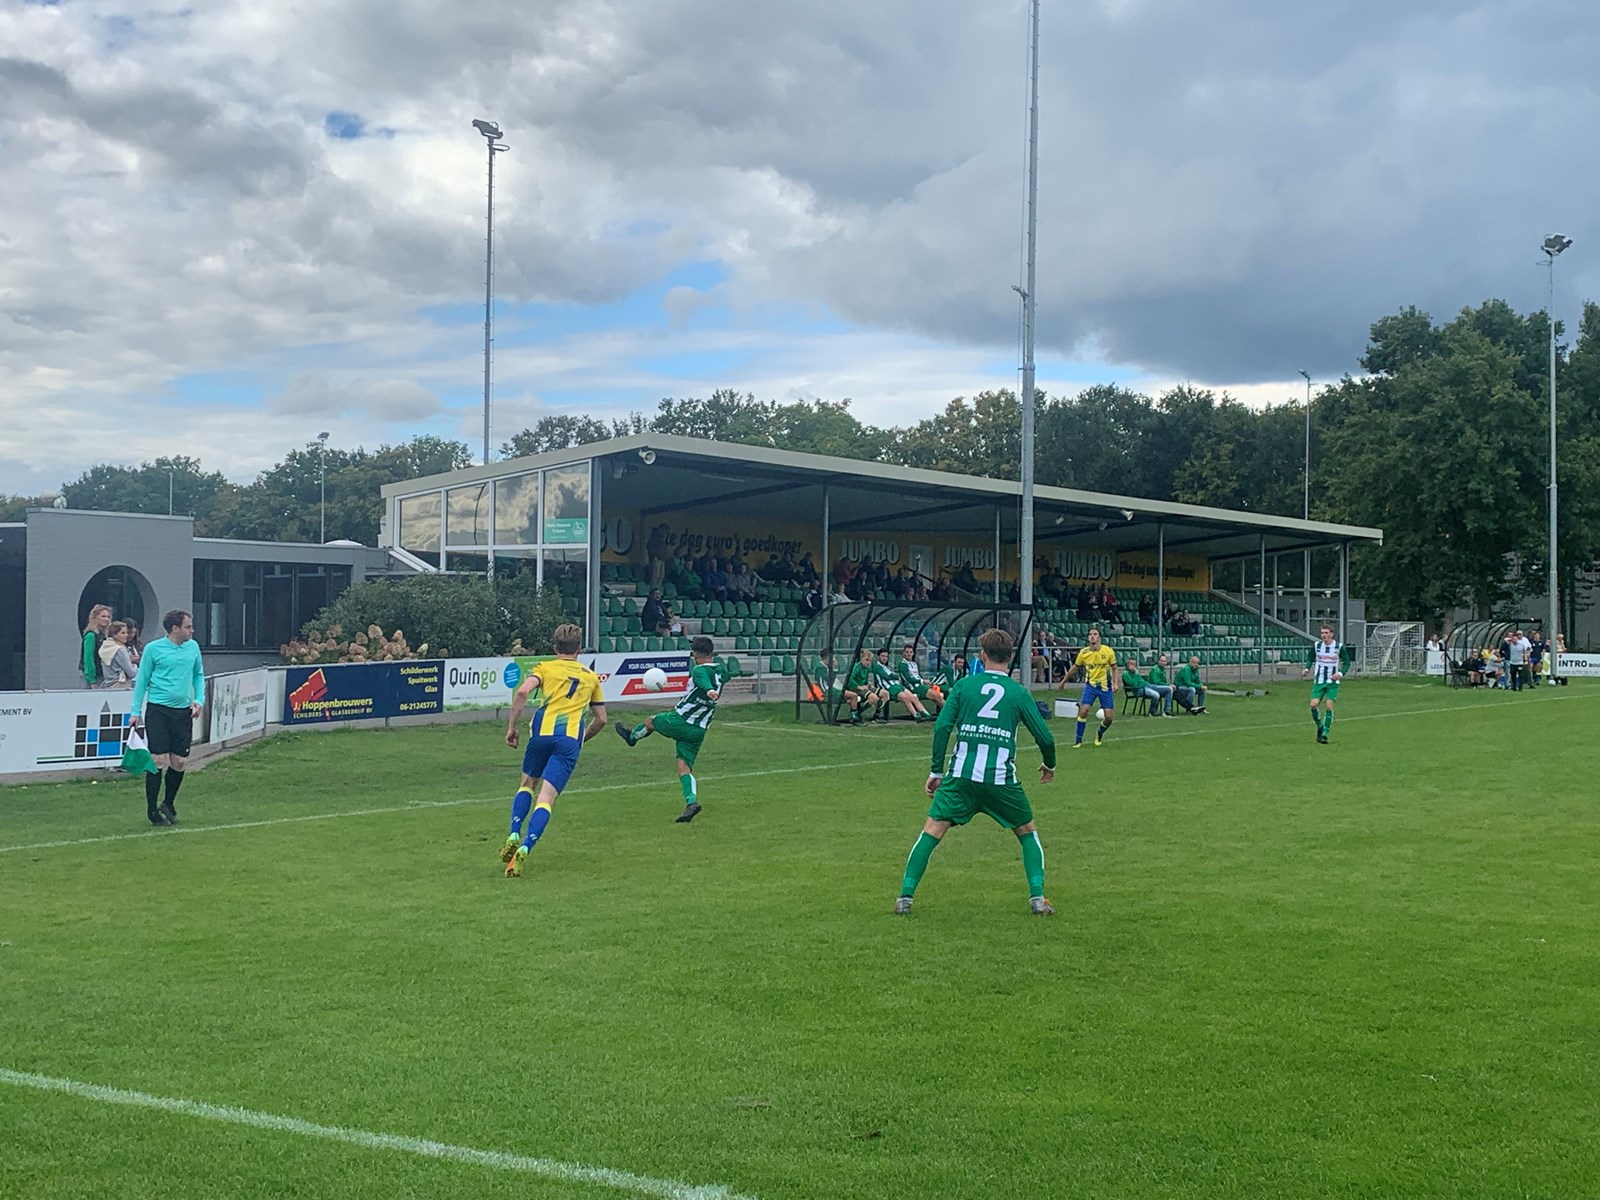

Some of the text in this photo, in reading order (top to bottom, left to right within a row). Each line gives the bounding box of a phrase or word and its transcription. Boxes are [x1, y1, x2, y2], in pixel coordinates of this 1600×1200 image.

[839, 538, 900, 564] JUMBO
[943, 546, 995, 570] JUMBO
[1055, 550, 1113, 581] JUMBO
[400, 666, 438, 675] Schilderwerk
[1558, 660, 1588, 668] INTRO
[449, 667, 497, 690] Quingo
[566, 676, 580, 700] 7
[302, 698, 373, 711] Hoppenbrouwers
[977, 682, 1005, 719] 2
[978, 724, 1011, 738] Straten
